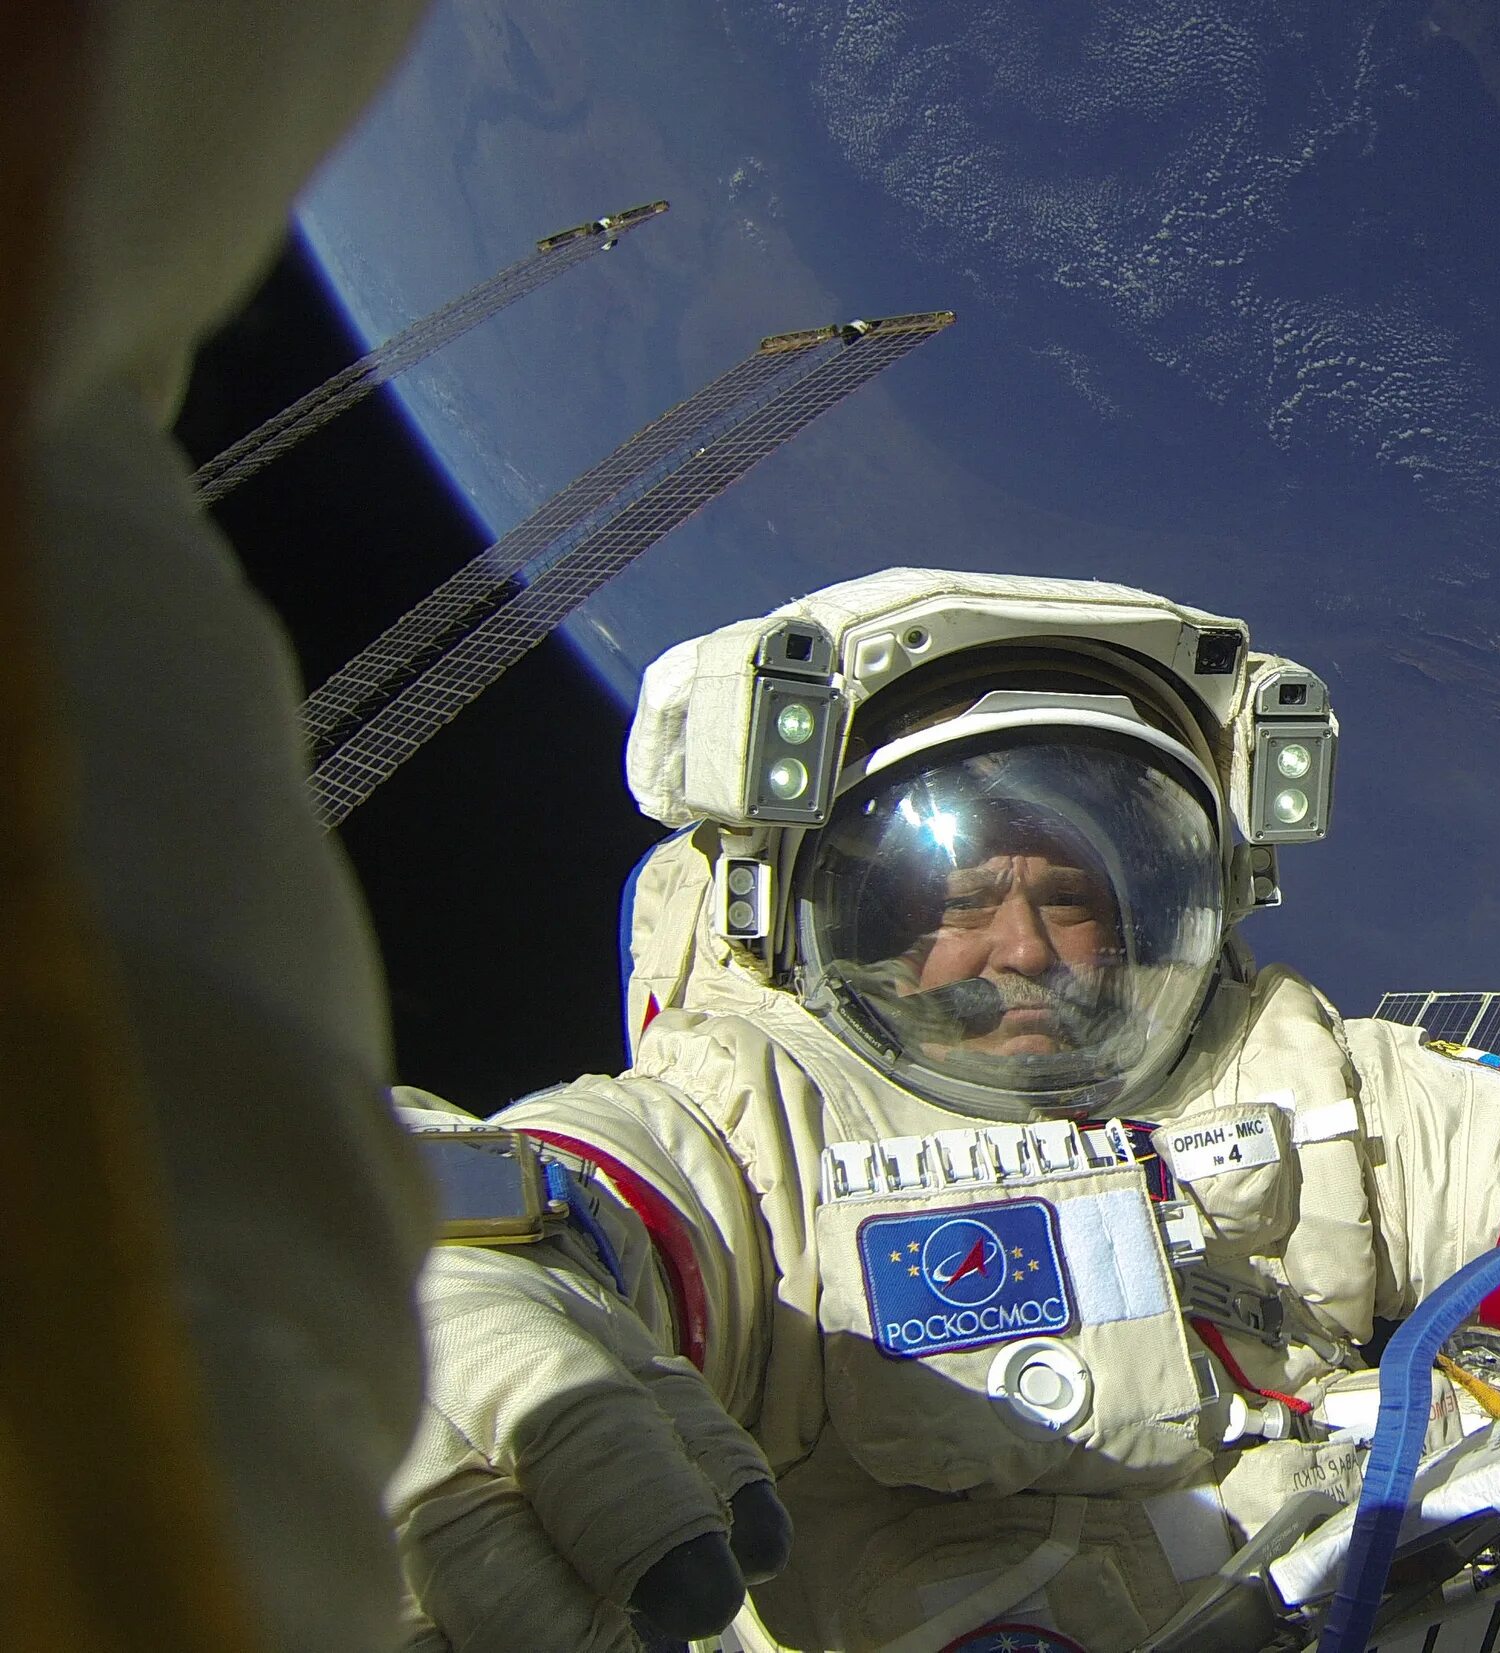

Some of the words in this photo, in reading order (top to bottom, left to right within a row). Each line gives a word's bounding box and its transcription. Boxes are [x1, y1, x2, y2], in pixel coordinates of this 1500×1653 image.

[1173, 1127, 1225, 1153] ОРЛАН
[1235, 1119, 1265, 1140] МКС
[1213, 1154, 1225, 1167] №
[1228, 1143, 1243, 1163] 4
[886, 1296, 1064, 1347] РОСКОСМОС
